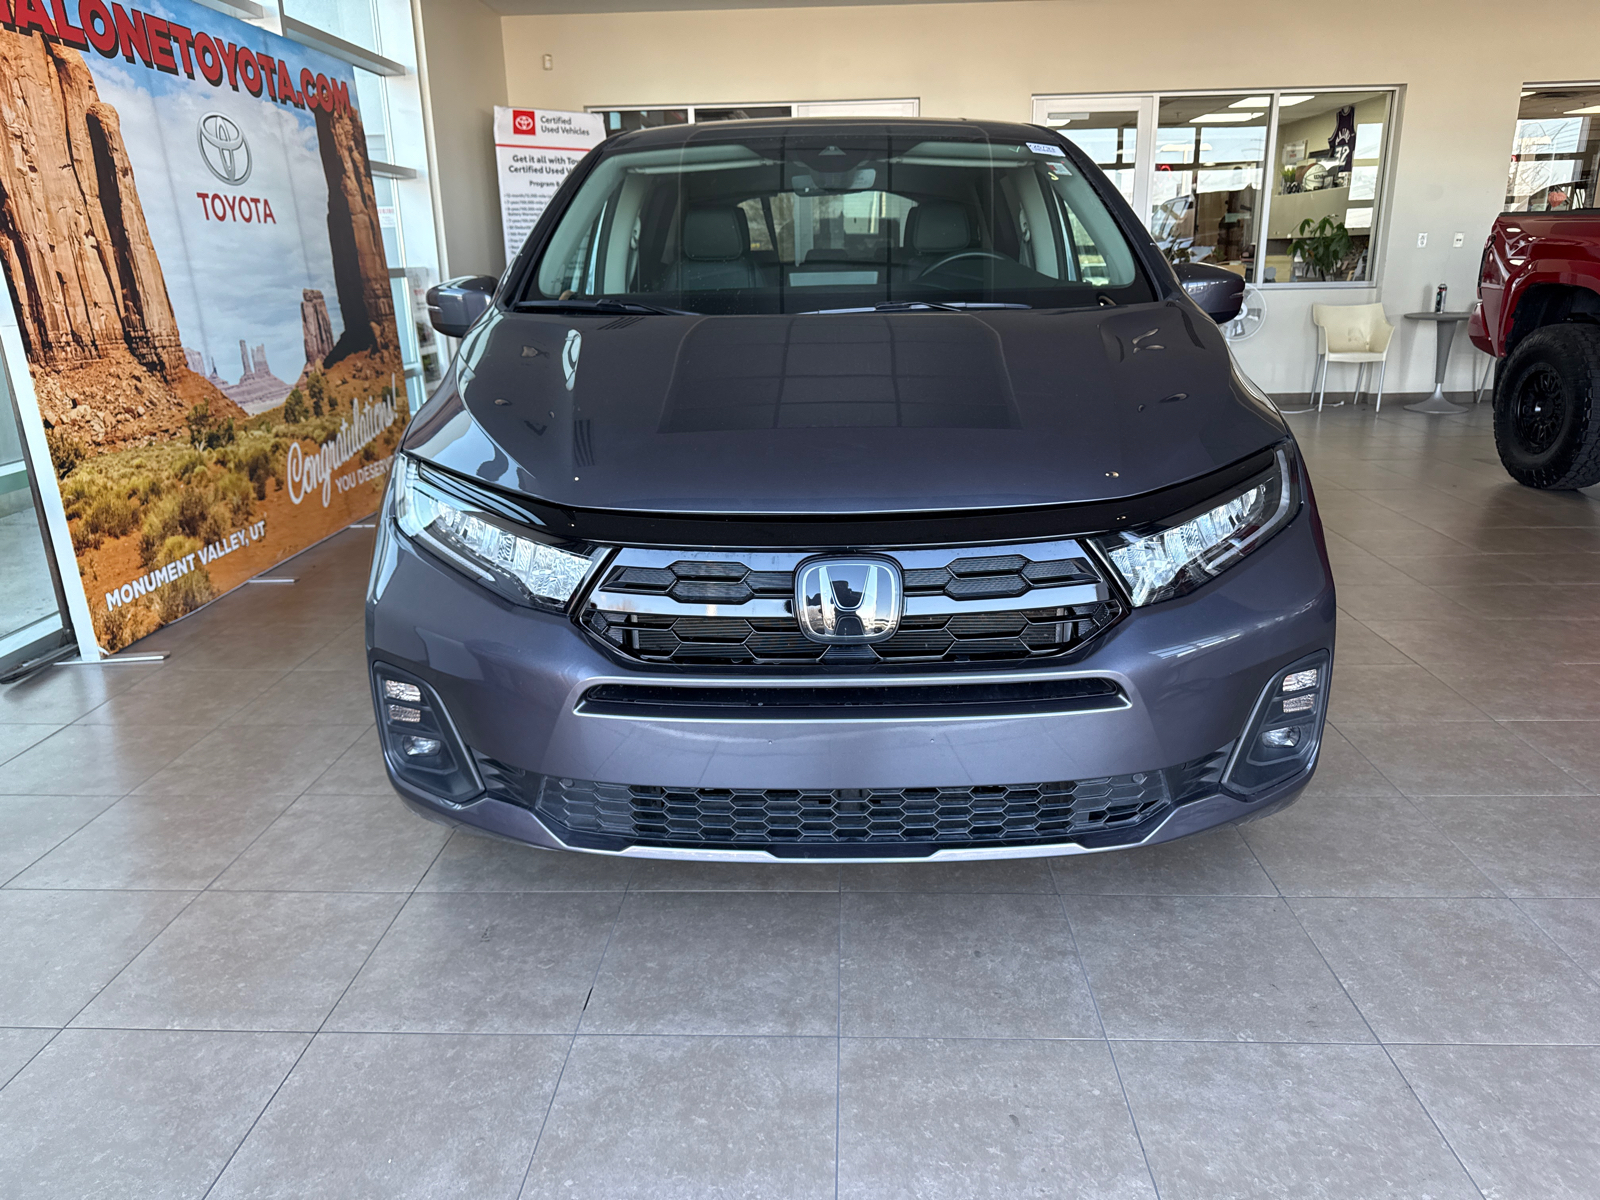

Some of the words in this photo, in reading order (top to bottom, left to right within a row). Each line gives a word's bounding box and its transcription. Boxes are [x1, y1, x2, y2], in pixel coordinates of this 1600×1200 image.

[0, 0, 352, 116] ALONETOYOTA.COM
[540, 116, 572, 126] Certified
[541, 126, 560, 134] Used
[562, 126, 590, 136] Vehicles
[512, 155, 527, 163] Get
[529, 155, 535, 164] it
[536, 156, 546, 164] all
[547, 156, 566, 165] with
[508, 165, 544, 174] Certified
[545, 166, 565, 175] Used
[529, 180, 555, 188] Program
[196, 192, 277, 225] TOYOTA
[287, 372, 398, 509] Congratulations!
[335, 472, 357, 494] YOU
[105, 553, 196, 612] MONUMENT
[197, 529, 250, 566] VALLEY,
[249, 520, 266, 542] UT
